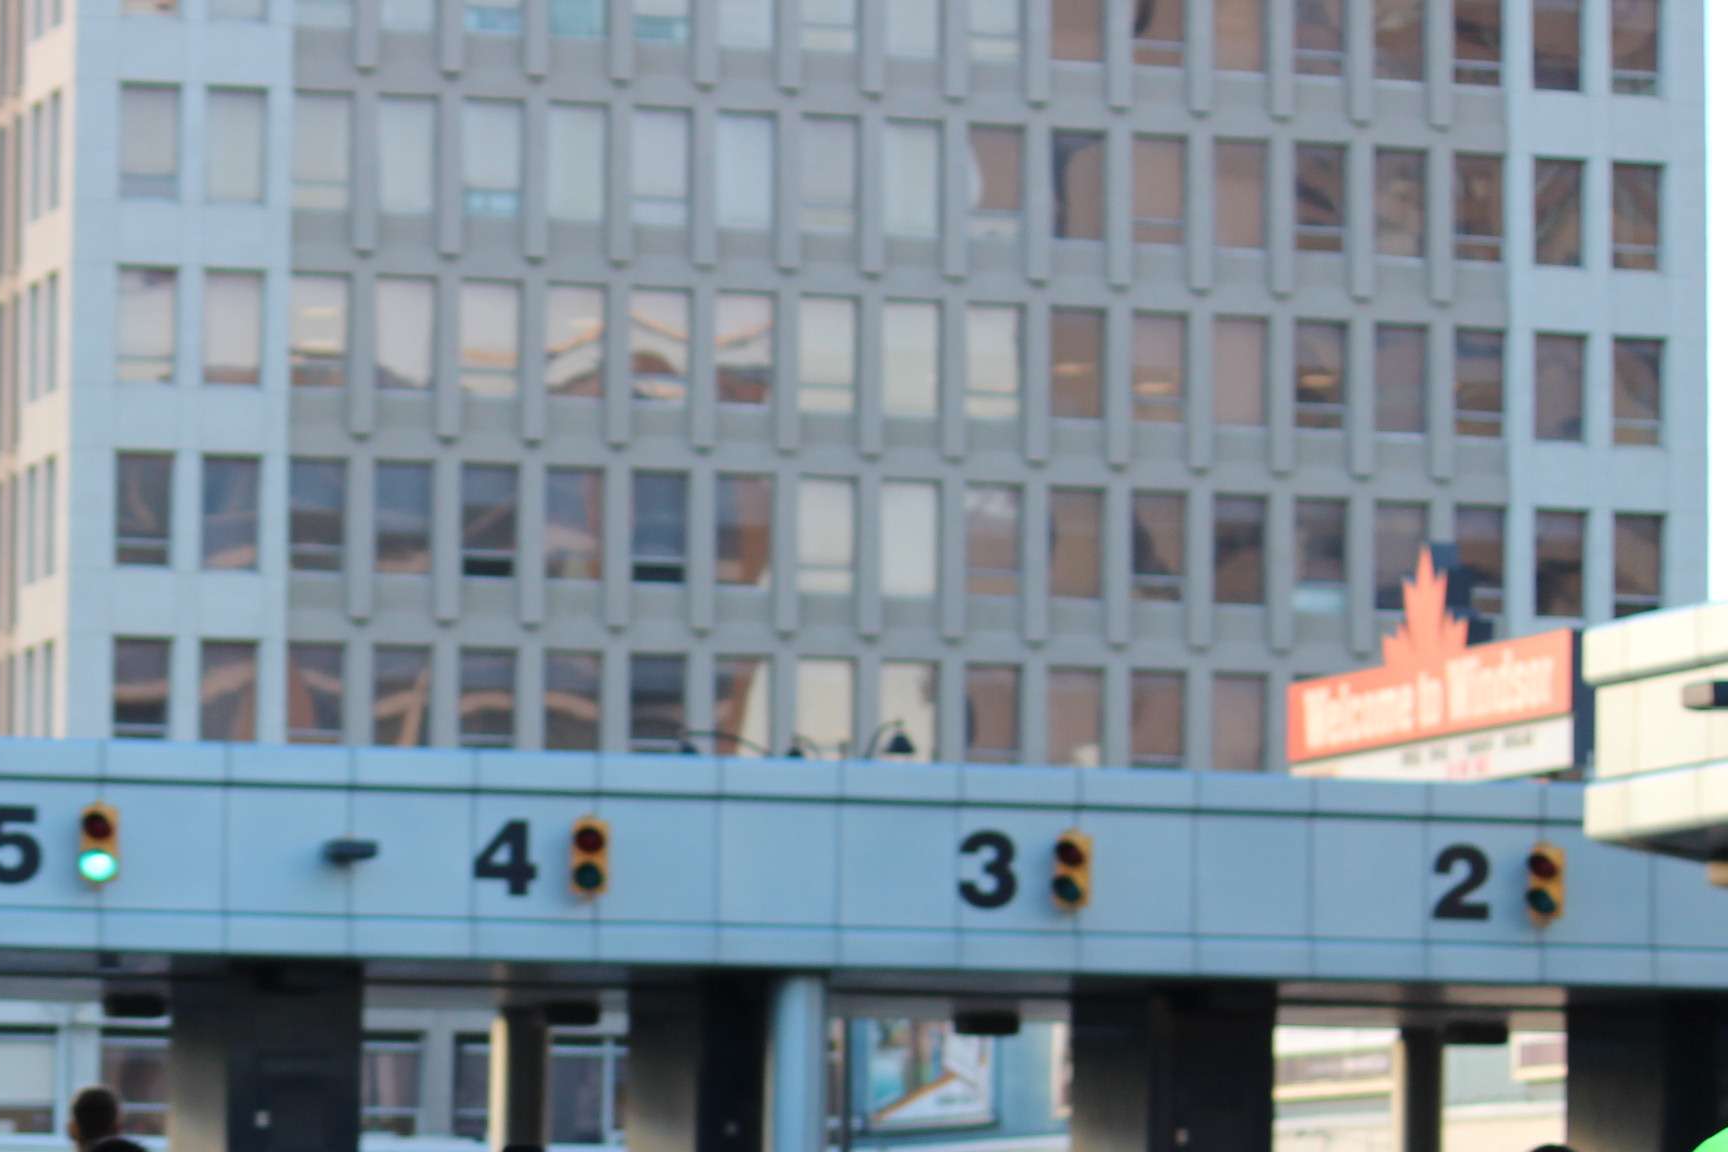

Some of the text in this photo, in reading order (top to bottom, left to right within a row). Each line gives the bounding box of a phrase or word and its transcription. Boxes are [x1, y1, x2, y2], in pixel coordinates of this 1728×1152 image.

[474, 819, 538, 896] 4
[957, 830, 1017, 909] 3
[1432, 843, 1491, 920] 2
